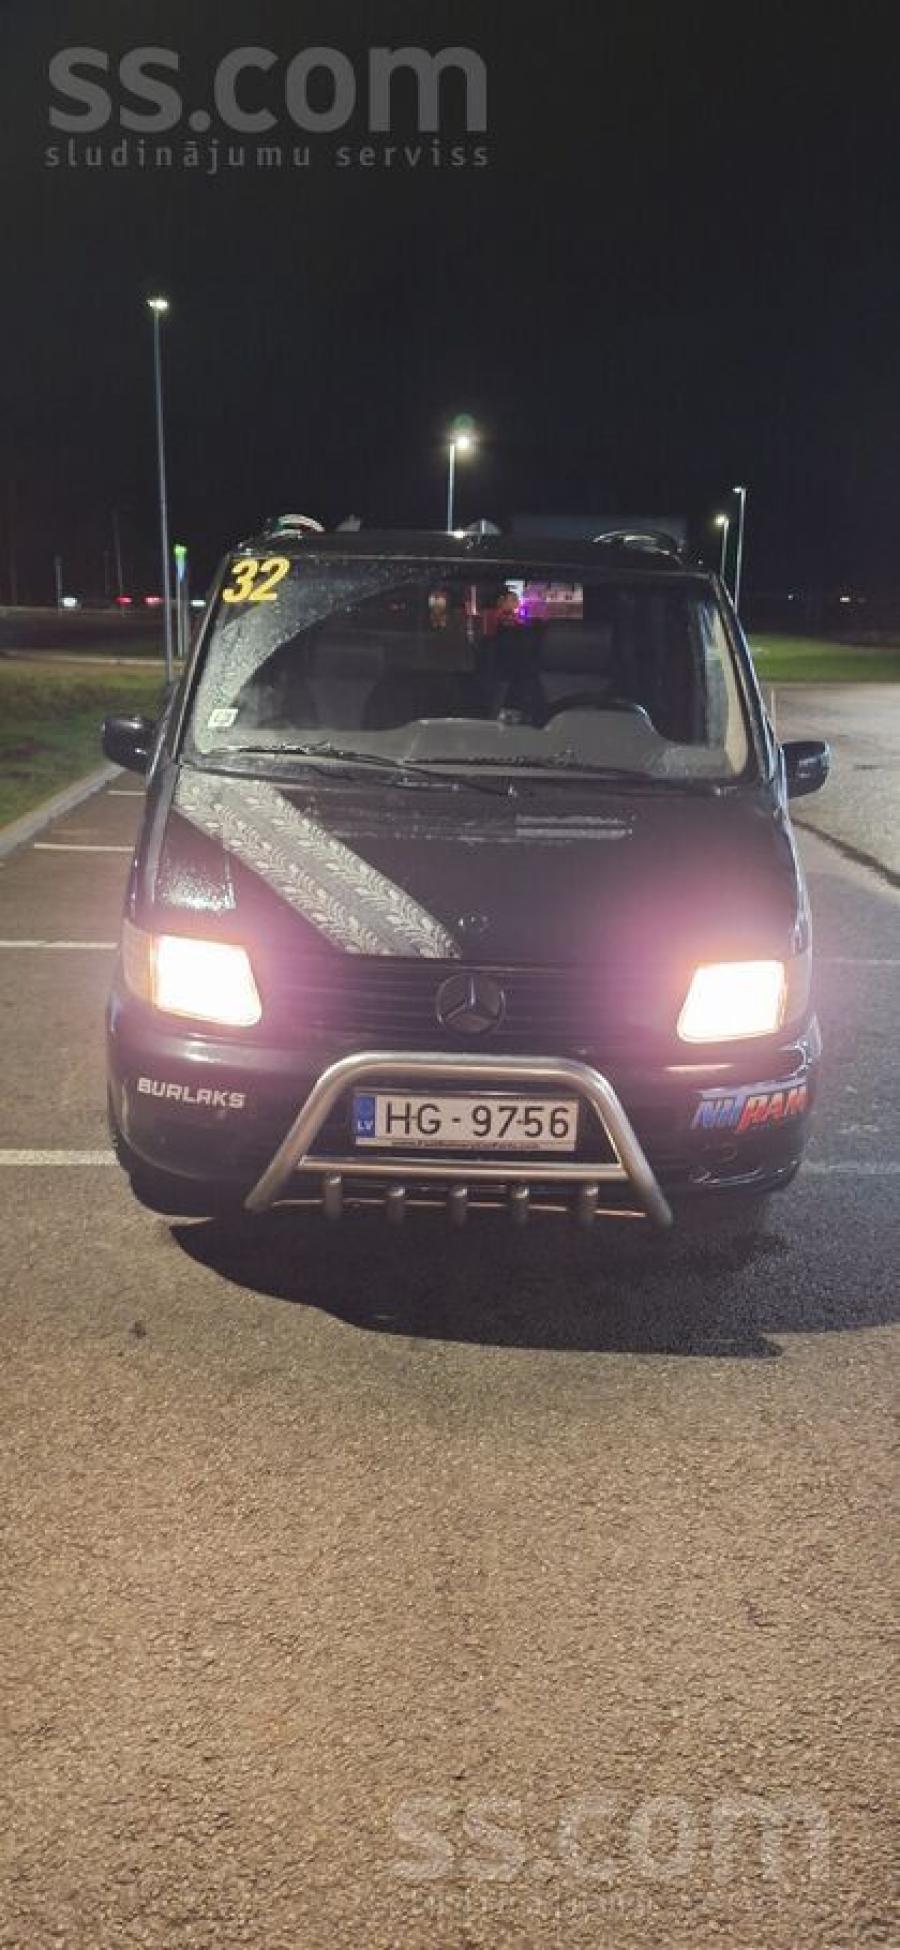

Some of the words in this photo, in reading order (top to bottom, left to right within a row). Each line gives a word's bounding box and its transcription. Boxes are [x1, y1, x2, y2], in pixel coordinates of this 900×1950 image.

[223, 557, 290, 602] 32
[137, 1077, 247, 1109] BURLAKS
[357, 1120, 374, 1130] LV
